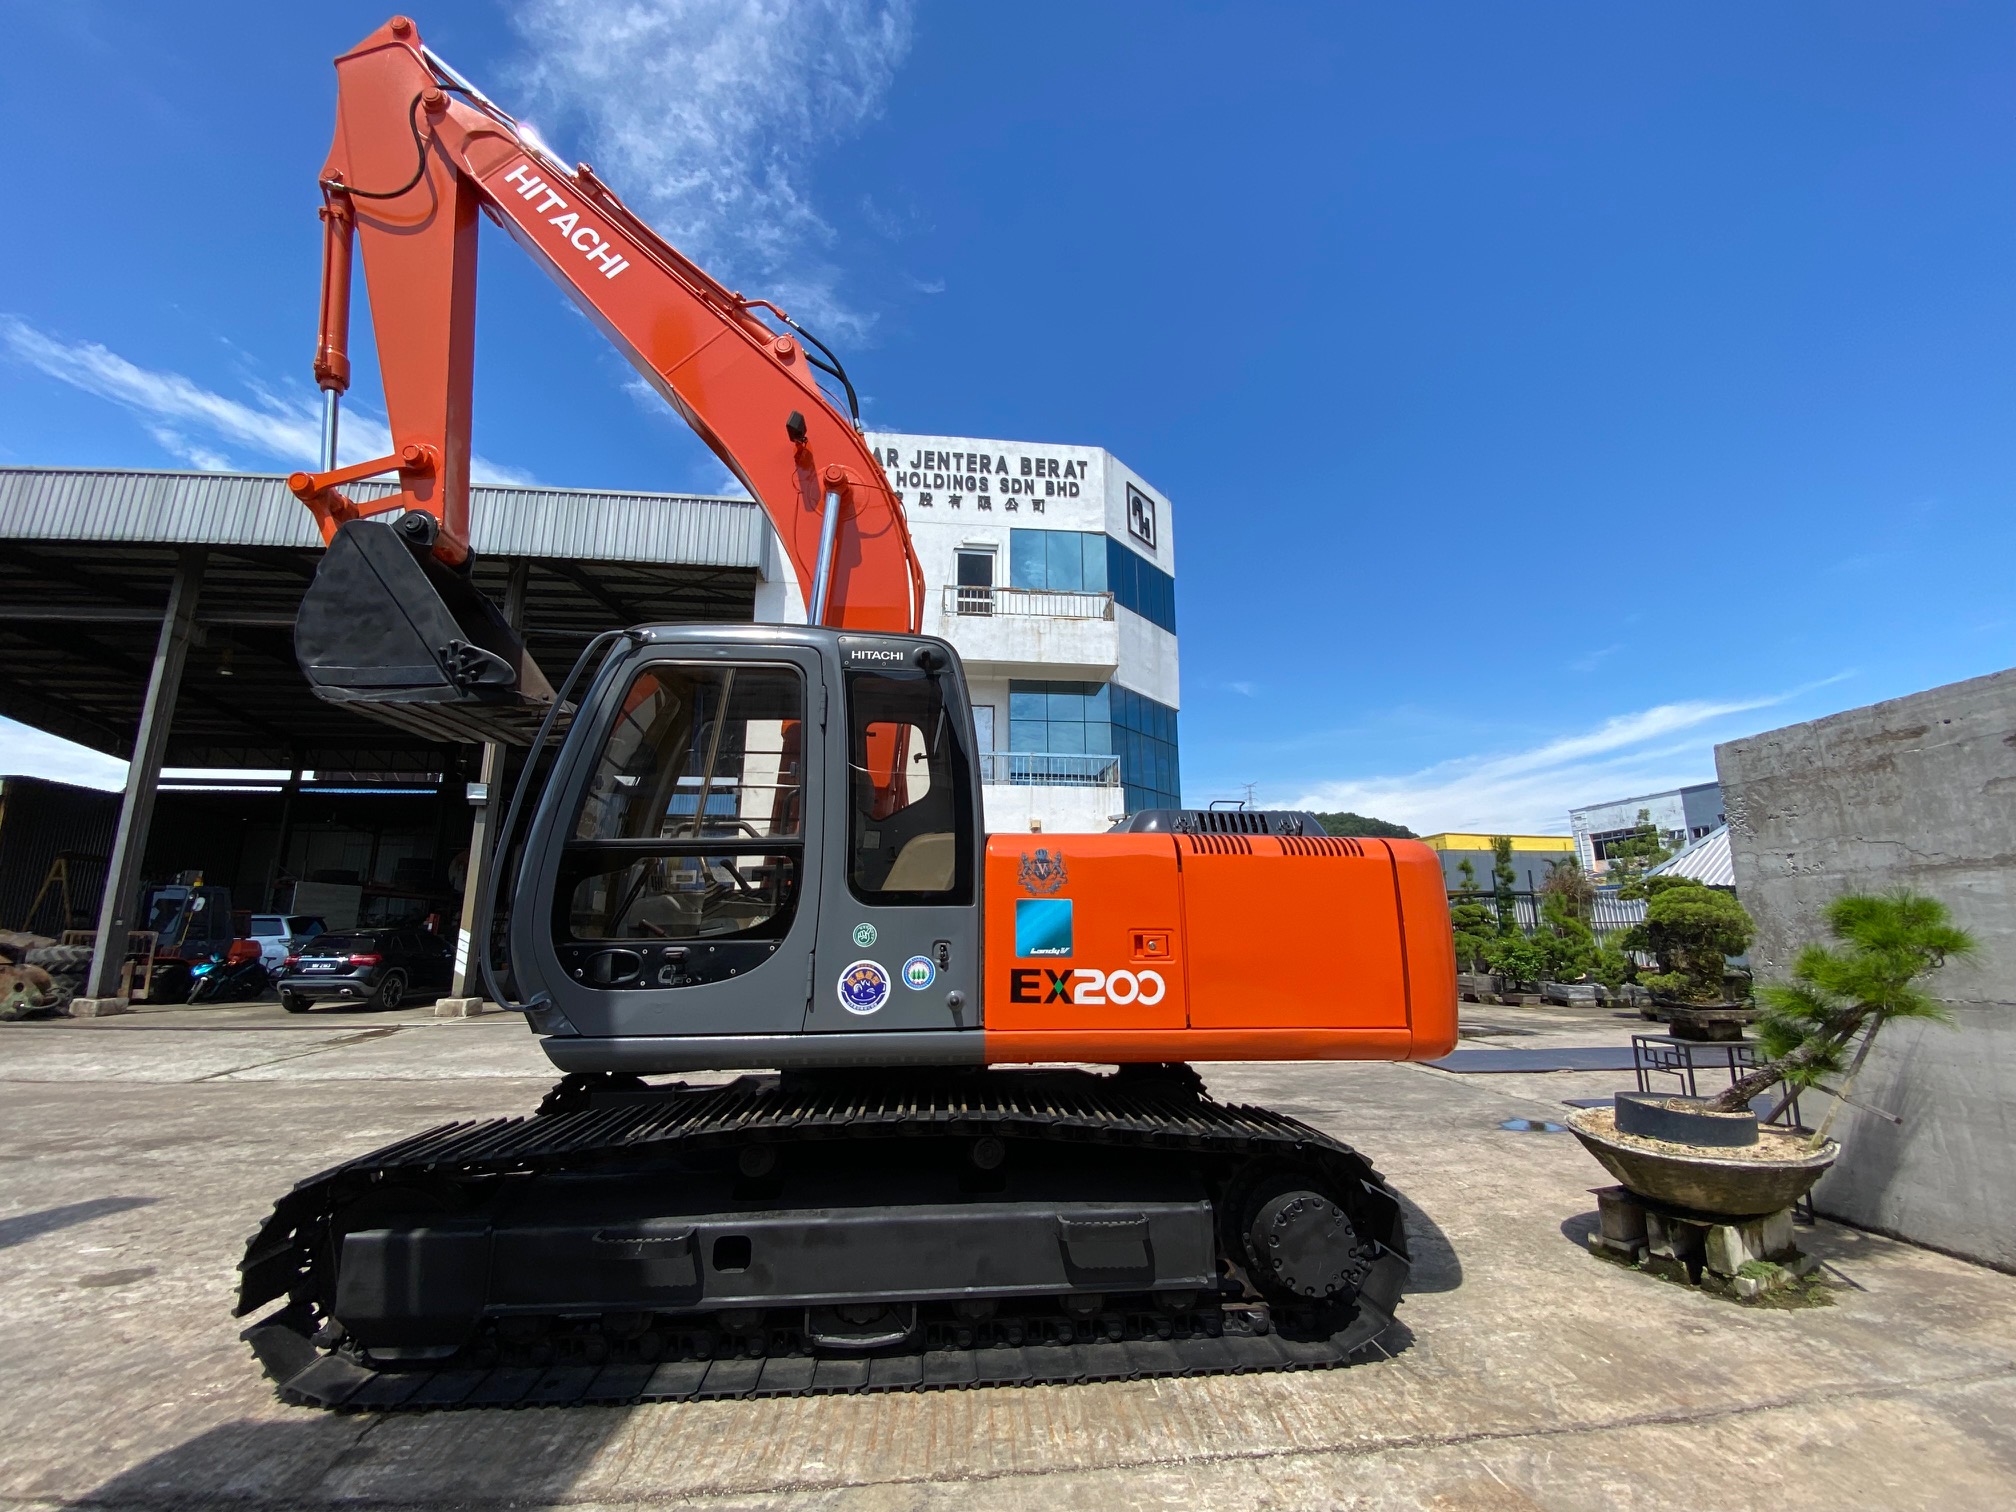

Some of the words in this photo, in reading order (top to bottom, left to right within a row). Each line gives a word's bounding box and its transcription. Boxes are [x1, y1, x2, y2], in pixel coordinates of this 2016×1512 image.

[504, 164, 630, 280] HITACHI
[910, 449, 1009, 476] JENTERA
[1020, 456, 1088, 480] BERAT
[896, 470, 989, 492] HOLDINGS
[1000, 477, 1035, 496] SDN
[1045, 480, 1080, 498] BHD
[851, 650, 904, 661] HITACHI
[1010, 968, 1166, 1006] EX200
